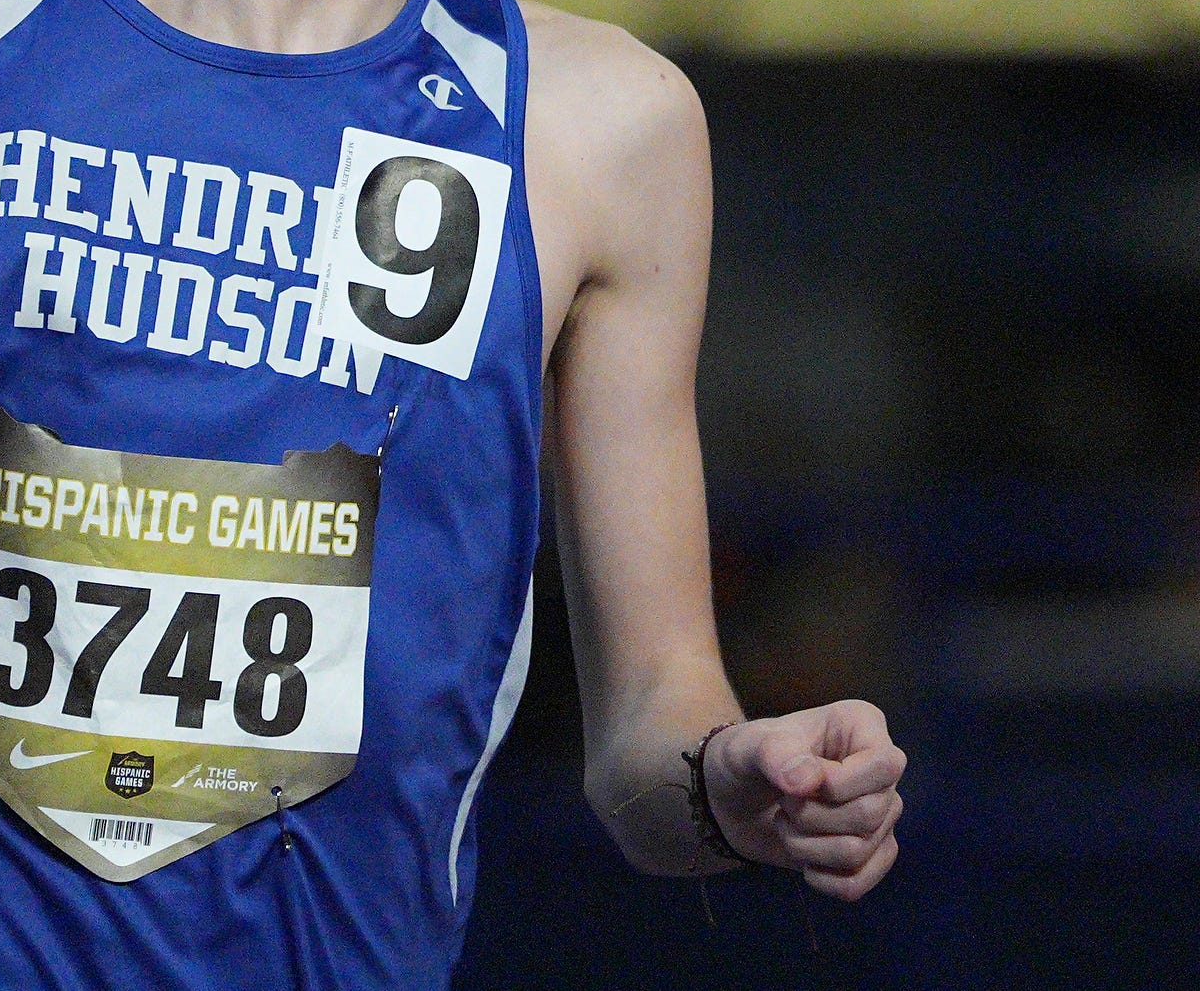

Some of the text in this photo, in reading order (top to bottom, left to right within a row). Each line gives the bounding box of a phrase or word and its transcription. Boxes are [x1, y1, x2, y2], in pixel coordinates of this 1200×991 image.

[348, 155, 481, 346] 9
[208, 492, 361, 557] GAMES
[110, 767, 151, 778] HISPANIC
[208, 767, 237, 779] THE
[115, 777, 144, 787] GAMES
[193, 778, 258, 792] ARMORY
